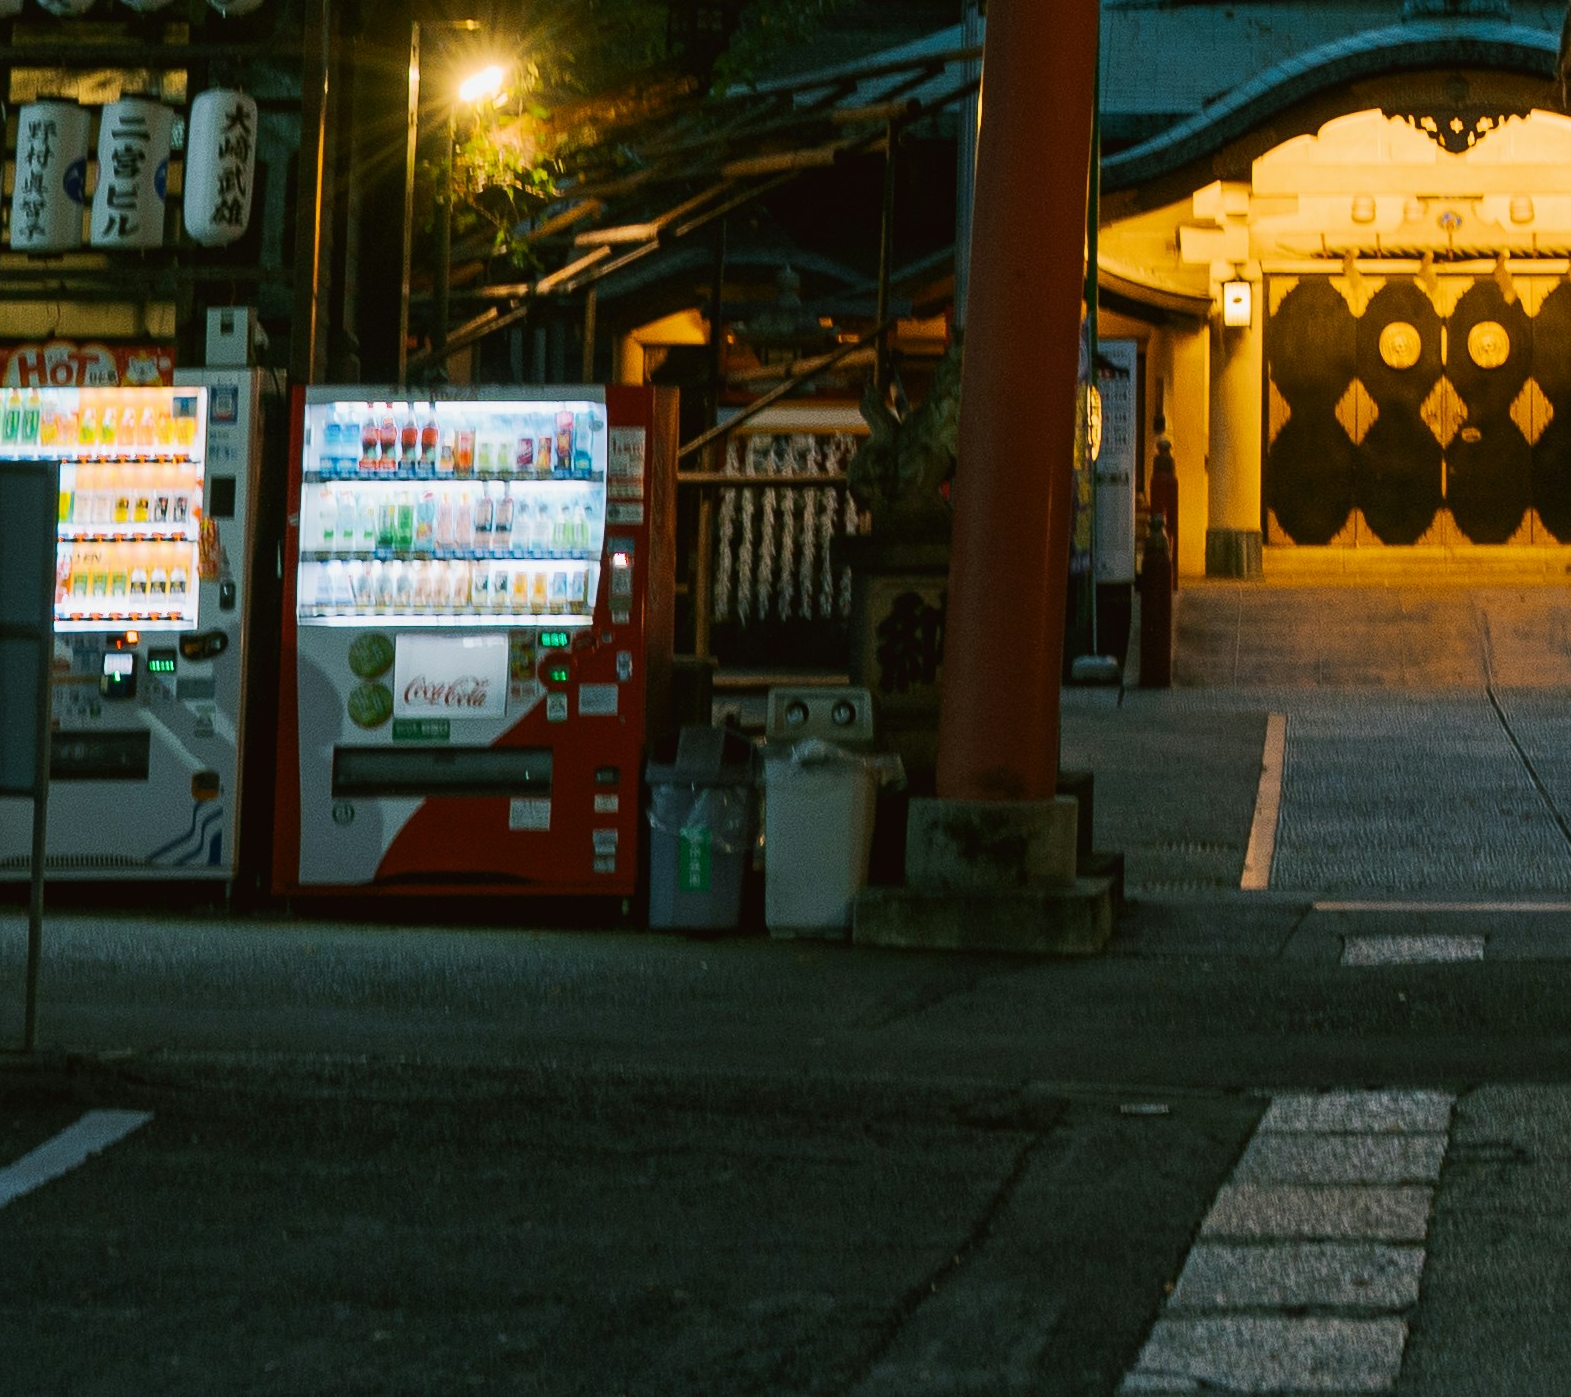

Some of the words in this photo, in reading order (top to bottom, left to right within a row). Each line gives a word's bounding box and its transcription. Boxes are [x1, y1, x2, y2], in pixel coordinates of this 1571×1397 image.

[102, 116, 151, 237] 二宮ビル
[208, 104, 252, 227] 大崎武雄
[403, 675, 489, 707] Coca-Cola
